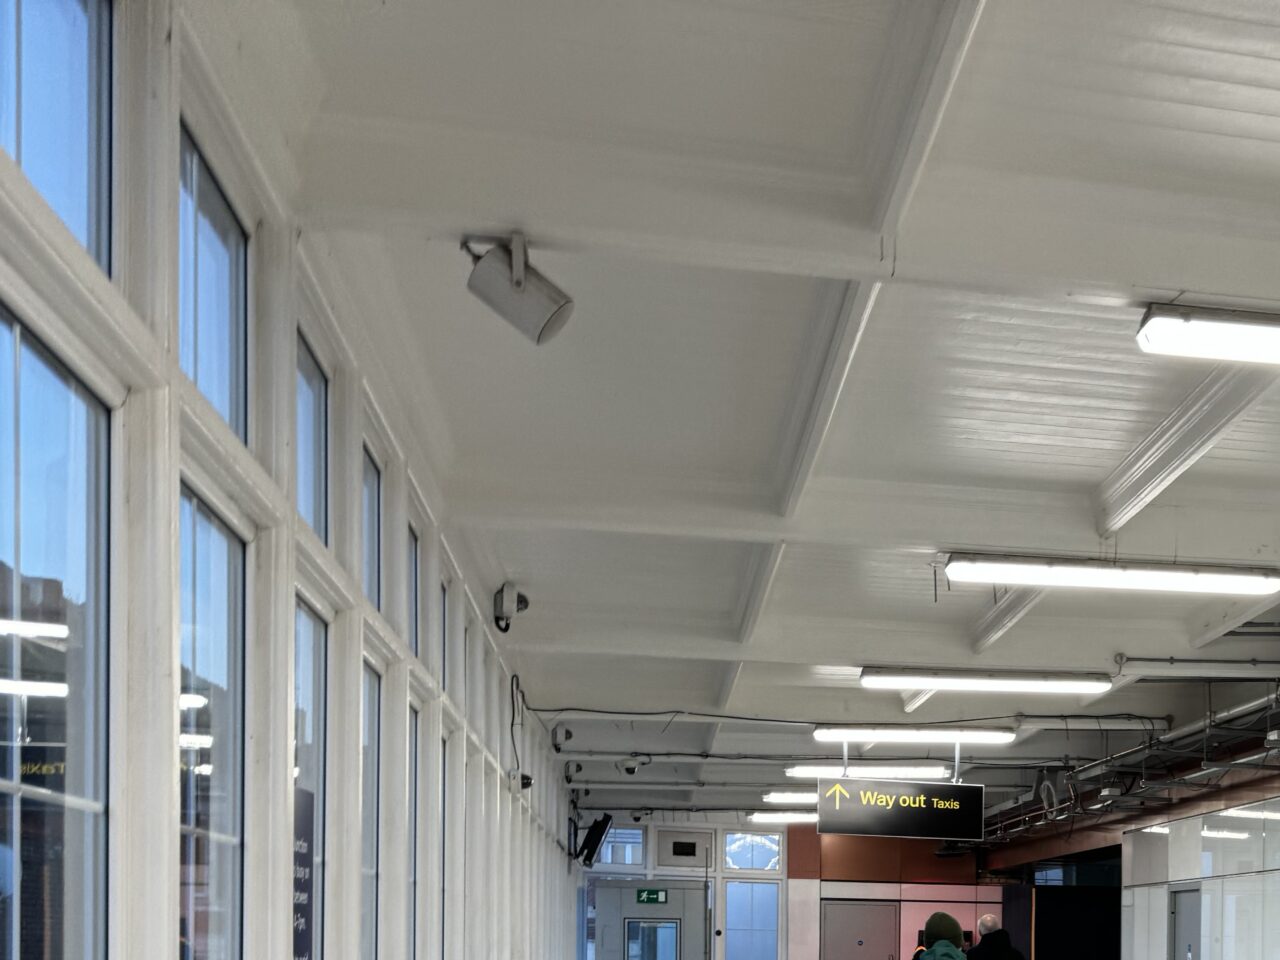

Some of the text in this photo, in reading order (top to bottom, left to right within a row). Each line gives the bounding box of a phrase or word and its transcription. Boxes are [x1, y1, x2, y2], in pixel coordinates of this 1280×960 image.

[859, 790, 960, 810] Way out Taxis
